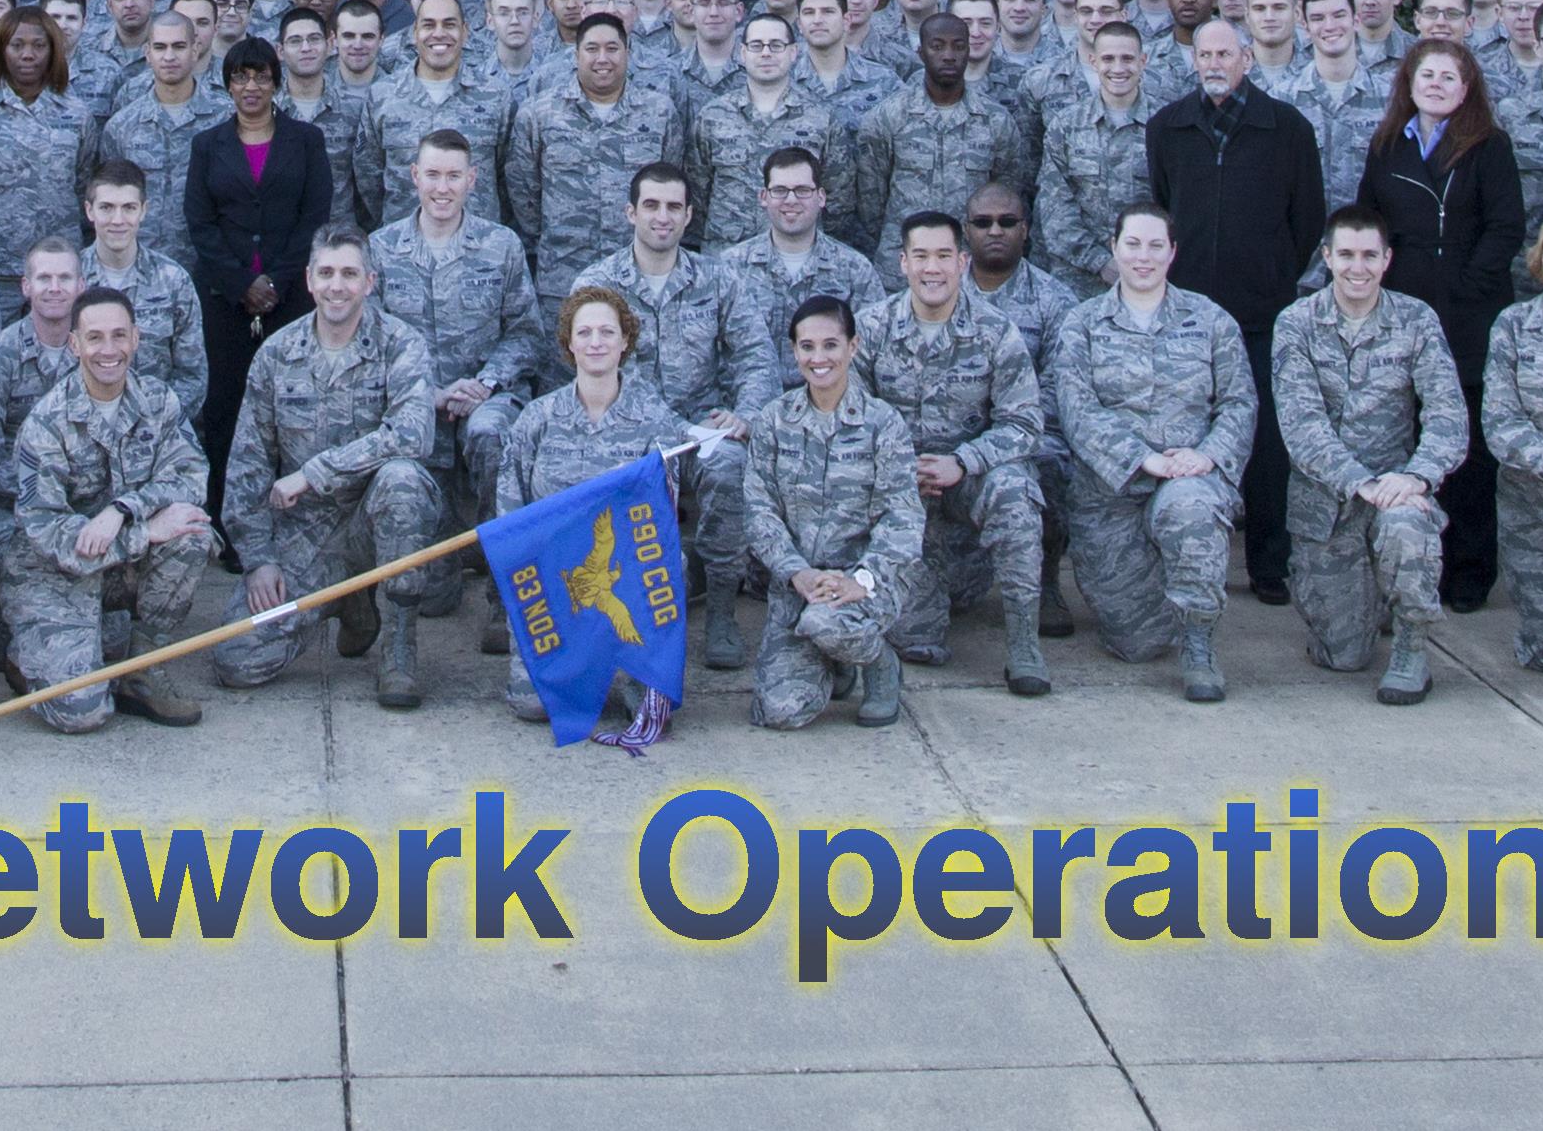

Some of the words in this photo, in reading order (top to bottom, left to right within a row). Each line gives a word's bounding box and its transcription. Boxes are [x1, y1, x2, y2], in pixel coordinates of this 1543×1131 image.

[629, 502, 663, 562] 690
[512, 564, 543, 601] 83
[642, 566, 678, 627] COG
[523, 598, 561, 655] NOS
